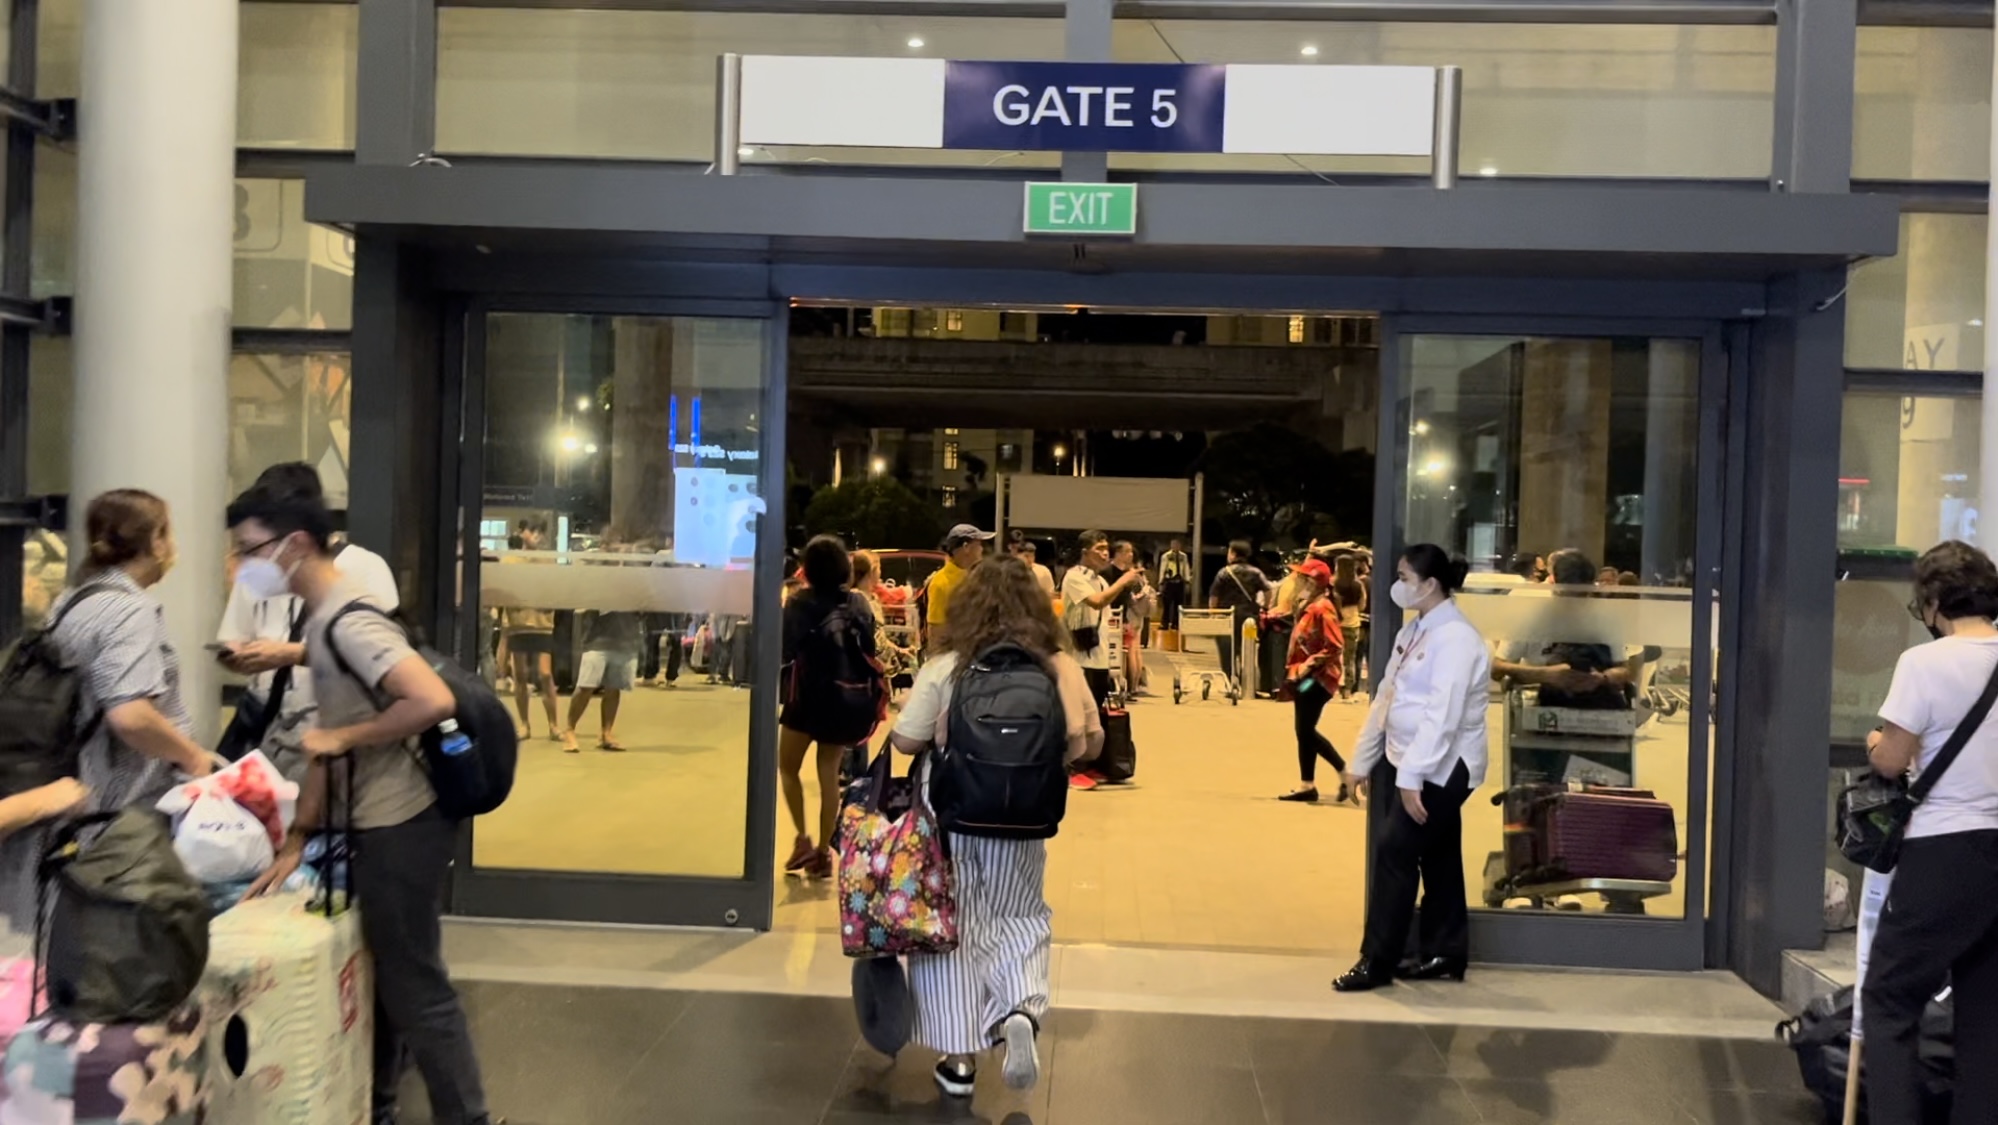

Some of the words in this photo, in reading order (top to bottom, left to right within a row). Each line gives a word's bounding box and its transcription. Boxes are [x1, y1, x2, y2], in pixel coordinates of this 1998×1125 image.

[993, 84, 1135, 127] GATE
[1150, 88, 1178, 128] 5
[1048, 191, 1114, 225] EXIT
